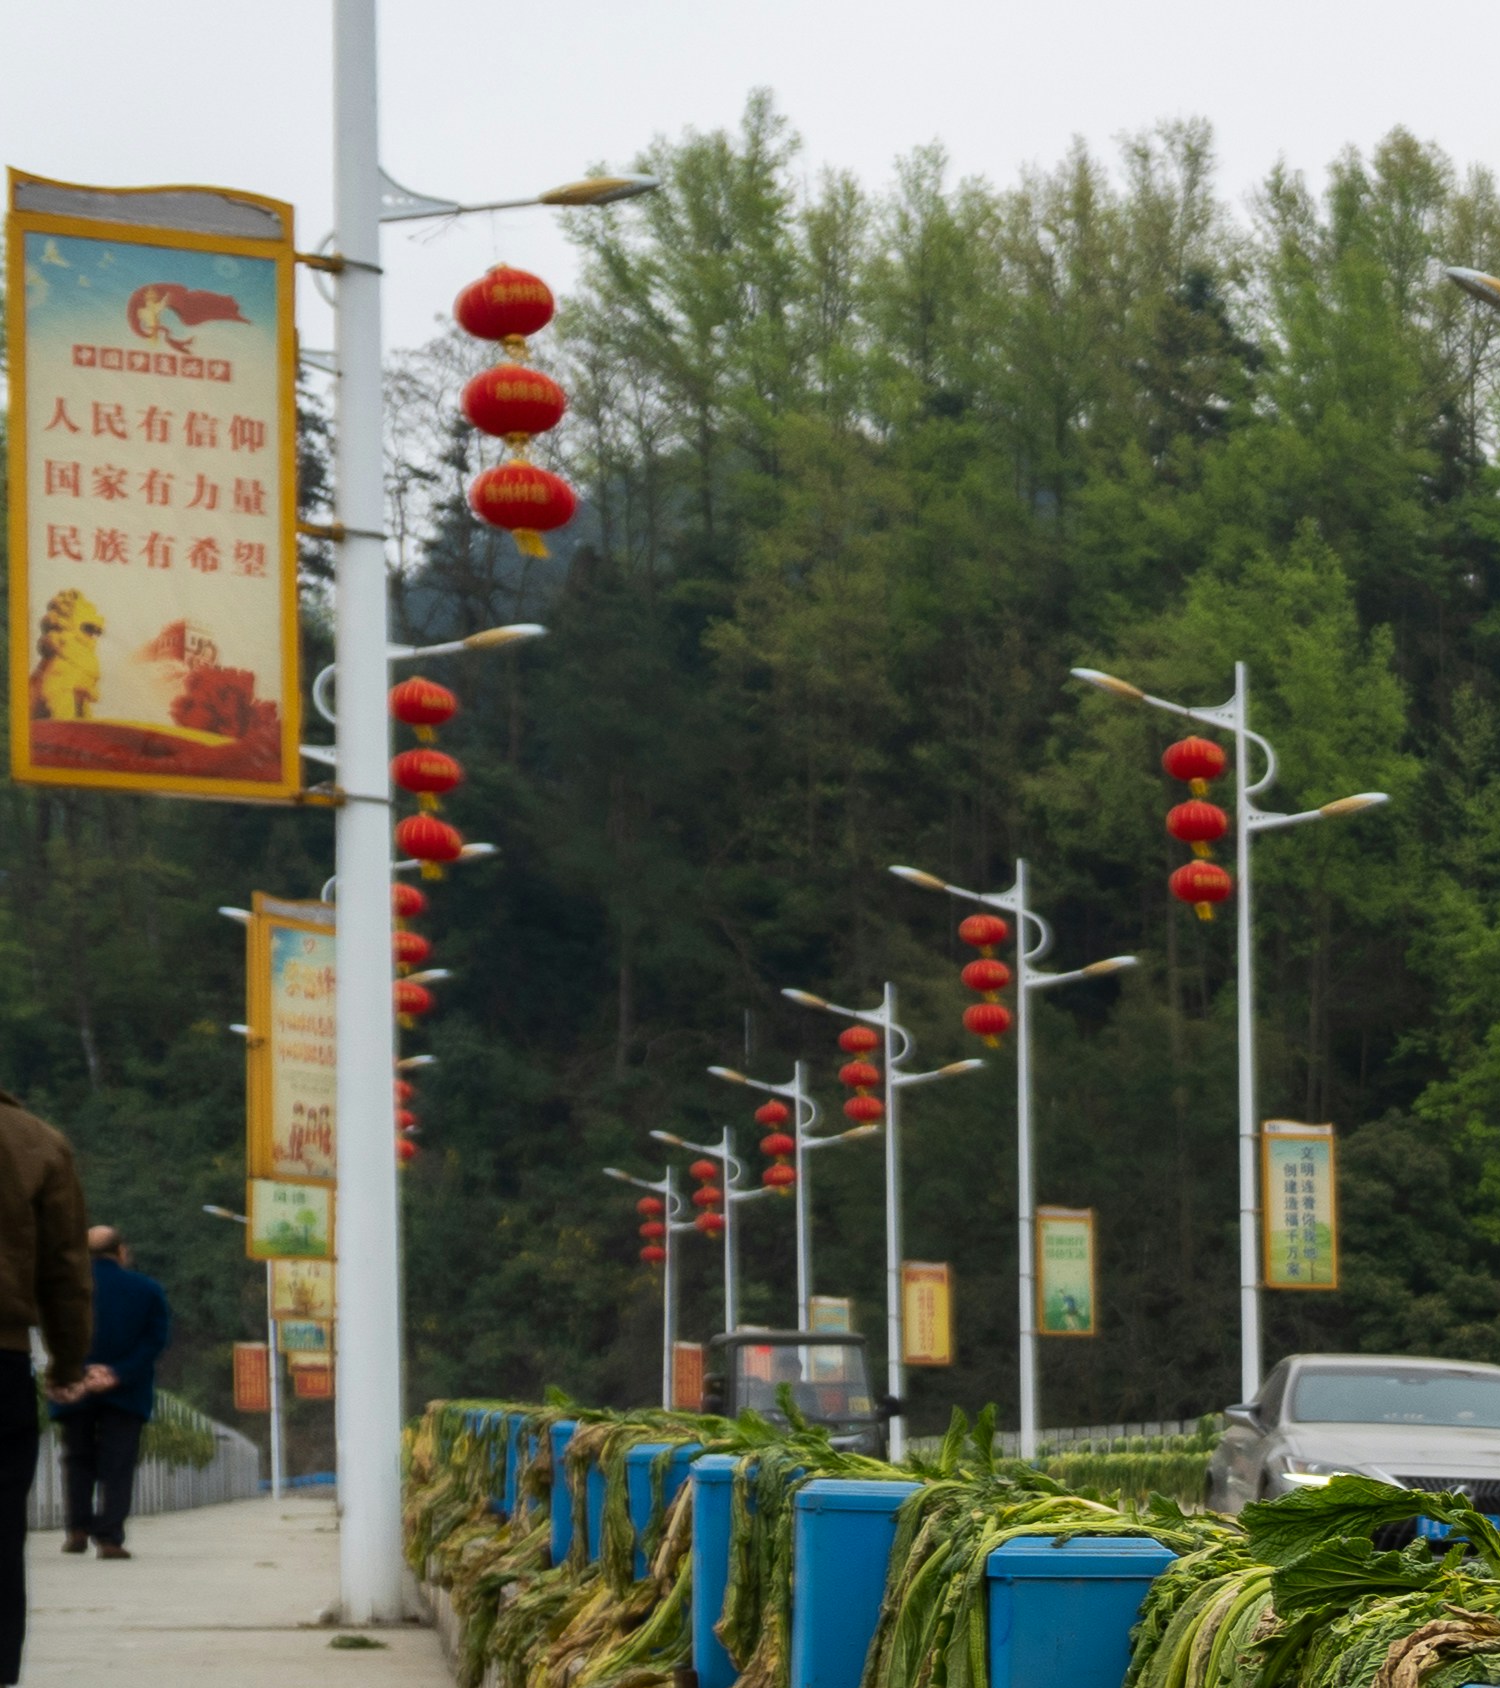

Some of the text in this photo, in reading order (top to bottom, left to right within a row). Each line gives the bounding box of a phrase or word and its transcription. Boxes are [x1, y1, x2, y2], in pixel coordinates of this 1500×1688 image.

[44, 397, 265, 453] 人民有信仰
[44, 459, 267, 516] 国家有力量
[47, 523, 267, 578] 民族有希望
